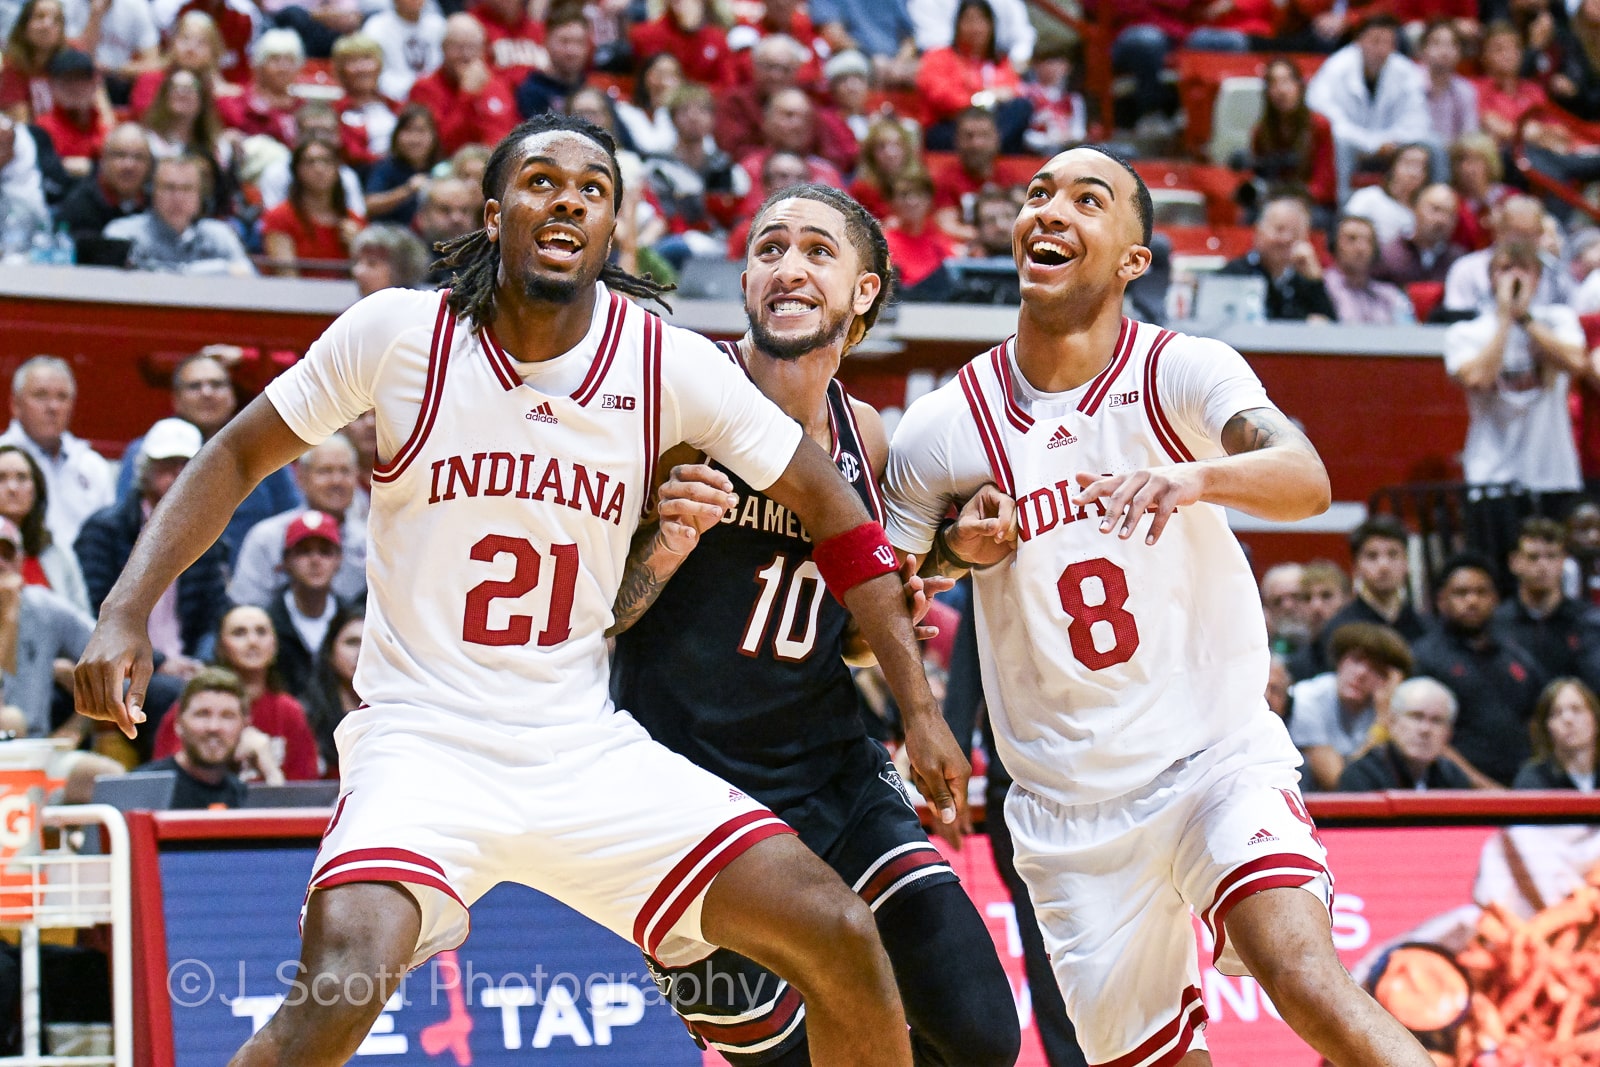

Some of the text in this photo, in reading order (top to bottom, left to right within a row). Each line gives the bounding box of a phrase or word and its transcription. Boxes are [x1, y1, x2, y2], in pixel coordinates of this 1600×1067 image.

[525, 412, 559, 425] adidas
[1047, 435, 1078, 450] adidas
[428, 452, 625, 525] INDIANA
[463, 534, 579, 646] 21
[738, 553, 827, 663] 10
[1057, 557, 1139, 671] 8
[1247, 836, 1280, 846] adidas
[232, 983, 645, 1056] TE TAP
